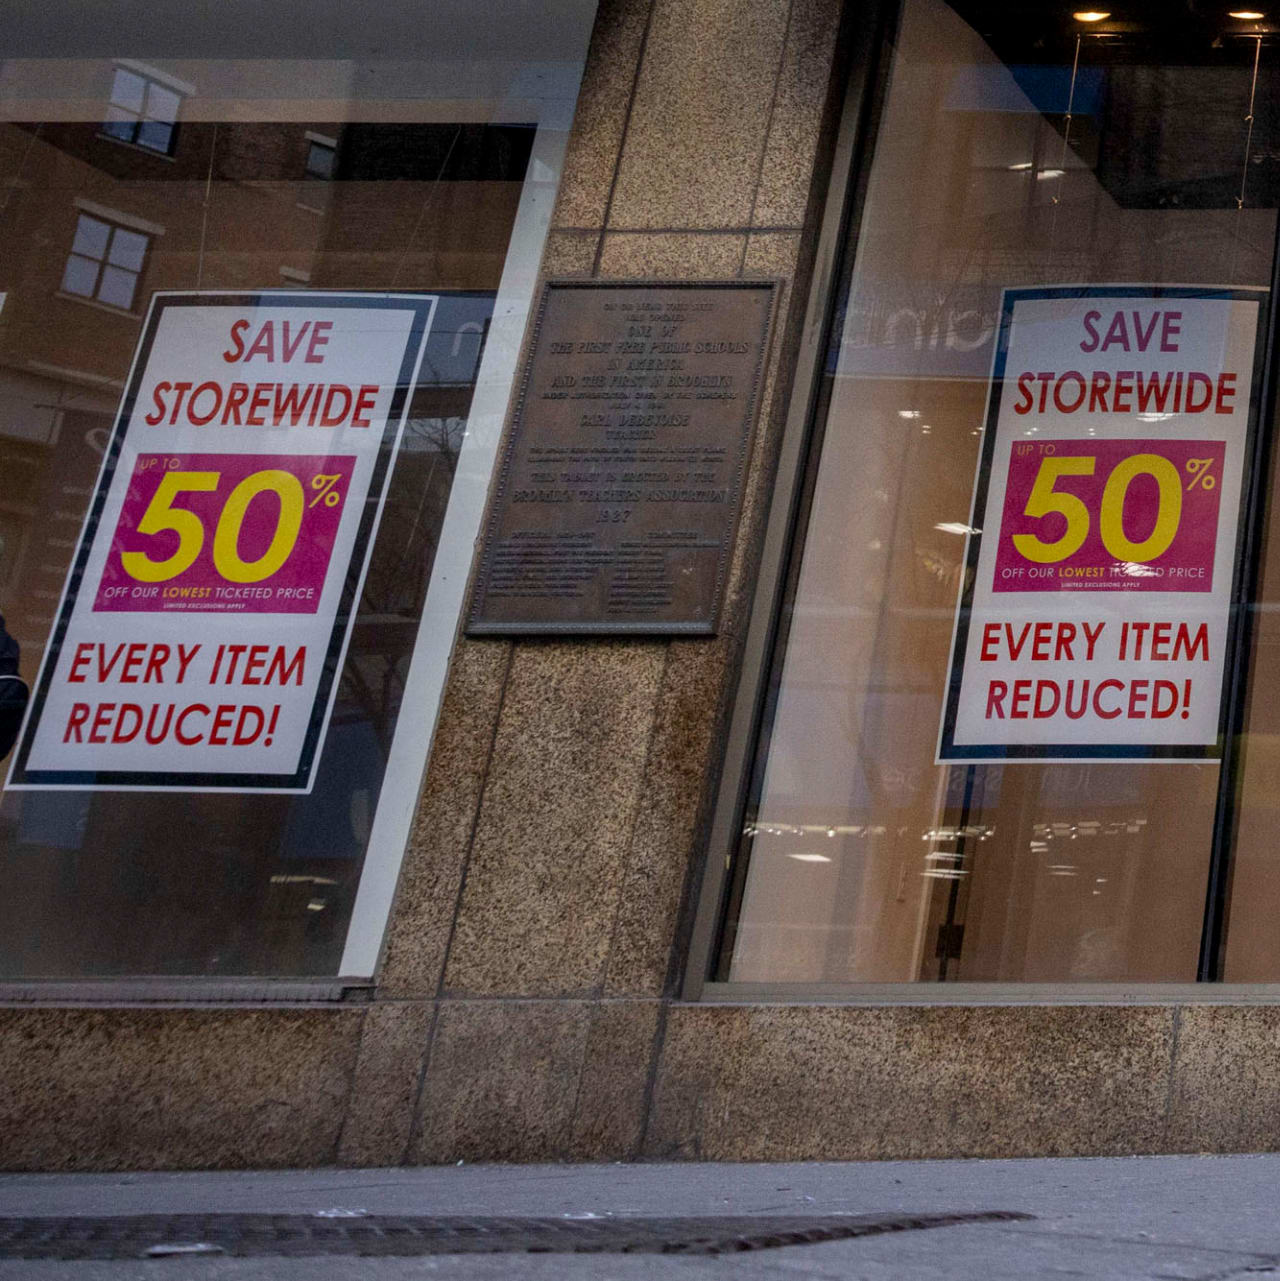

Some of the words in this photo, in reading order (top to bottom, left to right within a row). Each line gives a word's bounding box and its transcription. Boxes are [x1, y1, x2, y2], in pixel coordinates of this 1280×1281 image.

[223, 320, 333, 363] SAVE
[1079, 310, 1182, 353] SAVE
[145, 381, 379, 428] STOREWIDE
[1013, 371, 1237, 415] STOREWIDE
[139, 458, 158, 470] UP
[161, 457, 181, 470] TO
[1016, 445, 1034, 456] UP
[1038, 444, 1056, 455] TO
[120, 469, 341, 584] 50%
[1012, 453, 1216, 563] 50%
[103, 587, 128, 598] OFF
[131, 587, 158, 598] OUR
[162, 587, 211, 598] LOWEST
[215, 587, 273, 599] TICKETED
[276, 587, 315, 599] PRICE
[1001, 568, 1024, 578] OFF
[1028, 568, 1054, 578] OUR
[1058, 567, 1105, 578] LOWEST
[1109, 567, 1165, 578] TICED
[1168, 567, 1205, 578] PRICE
[979, 622, 1105, 662] EVERY
[1118, 622, 1210, 662] ITEM
[67, 642, 201, 684] EVERY
[209, 645, 307, 687] ITEM
[985, 679, 1192, 720] REDUCED!
[62, 703, 281, 747] REDUCED!
